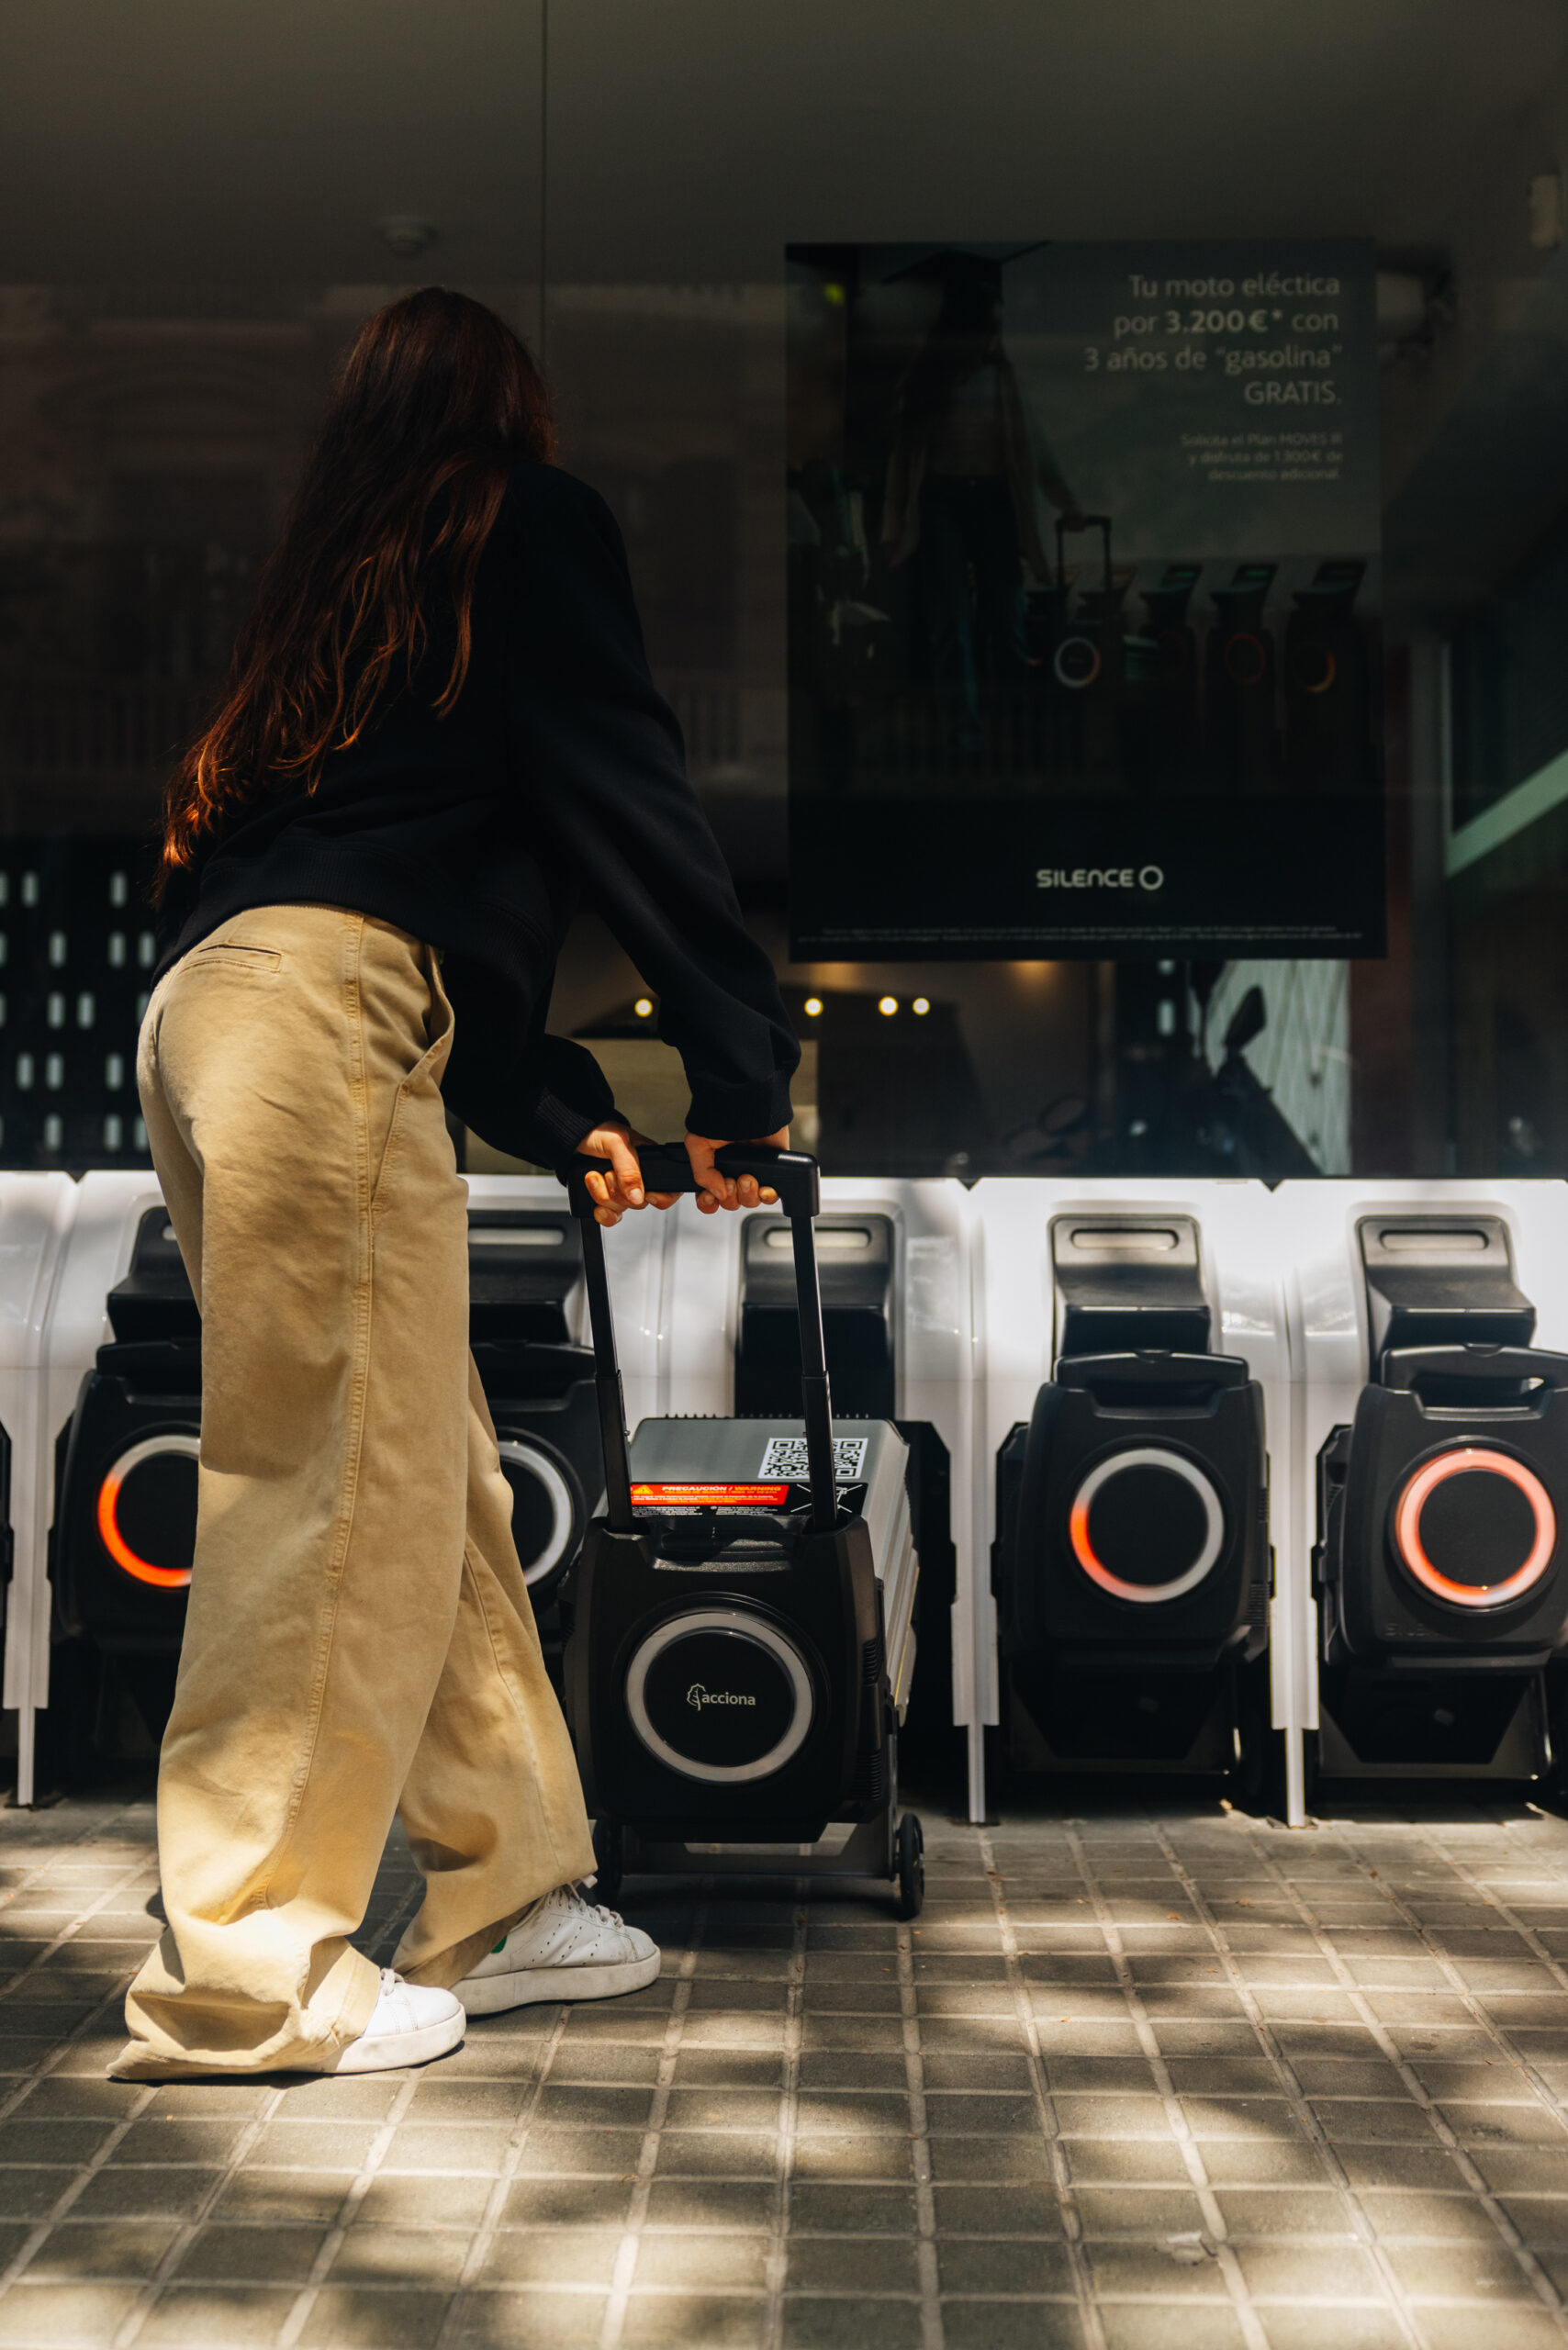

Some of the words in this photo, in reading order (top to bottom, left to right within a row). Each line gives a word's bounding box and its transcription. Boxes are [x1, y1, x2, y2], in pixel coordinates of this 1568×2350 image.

[1129, 274, 1158, 298] Tu
[1165, 276, 1235, 297] moto
[1241, 272, 1340, 297] eléctica
[1114, 315, 1159, 340] por
[1291, 313, 1339, 331] con
[1083, 347, 1100, 371] 3
[1106, 347, 1168, 371] años
[1174, 345, 1207, 370] de
[1244, 381, 1342, 406] GRATIS.
[1036, 868, 1135, 888] SILENCE
[701, 1692, 756, 1706] acciona
